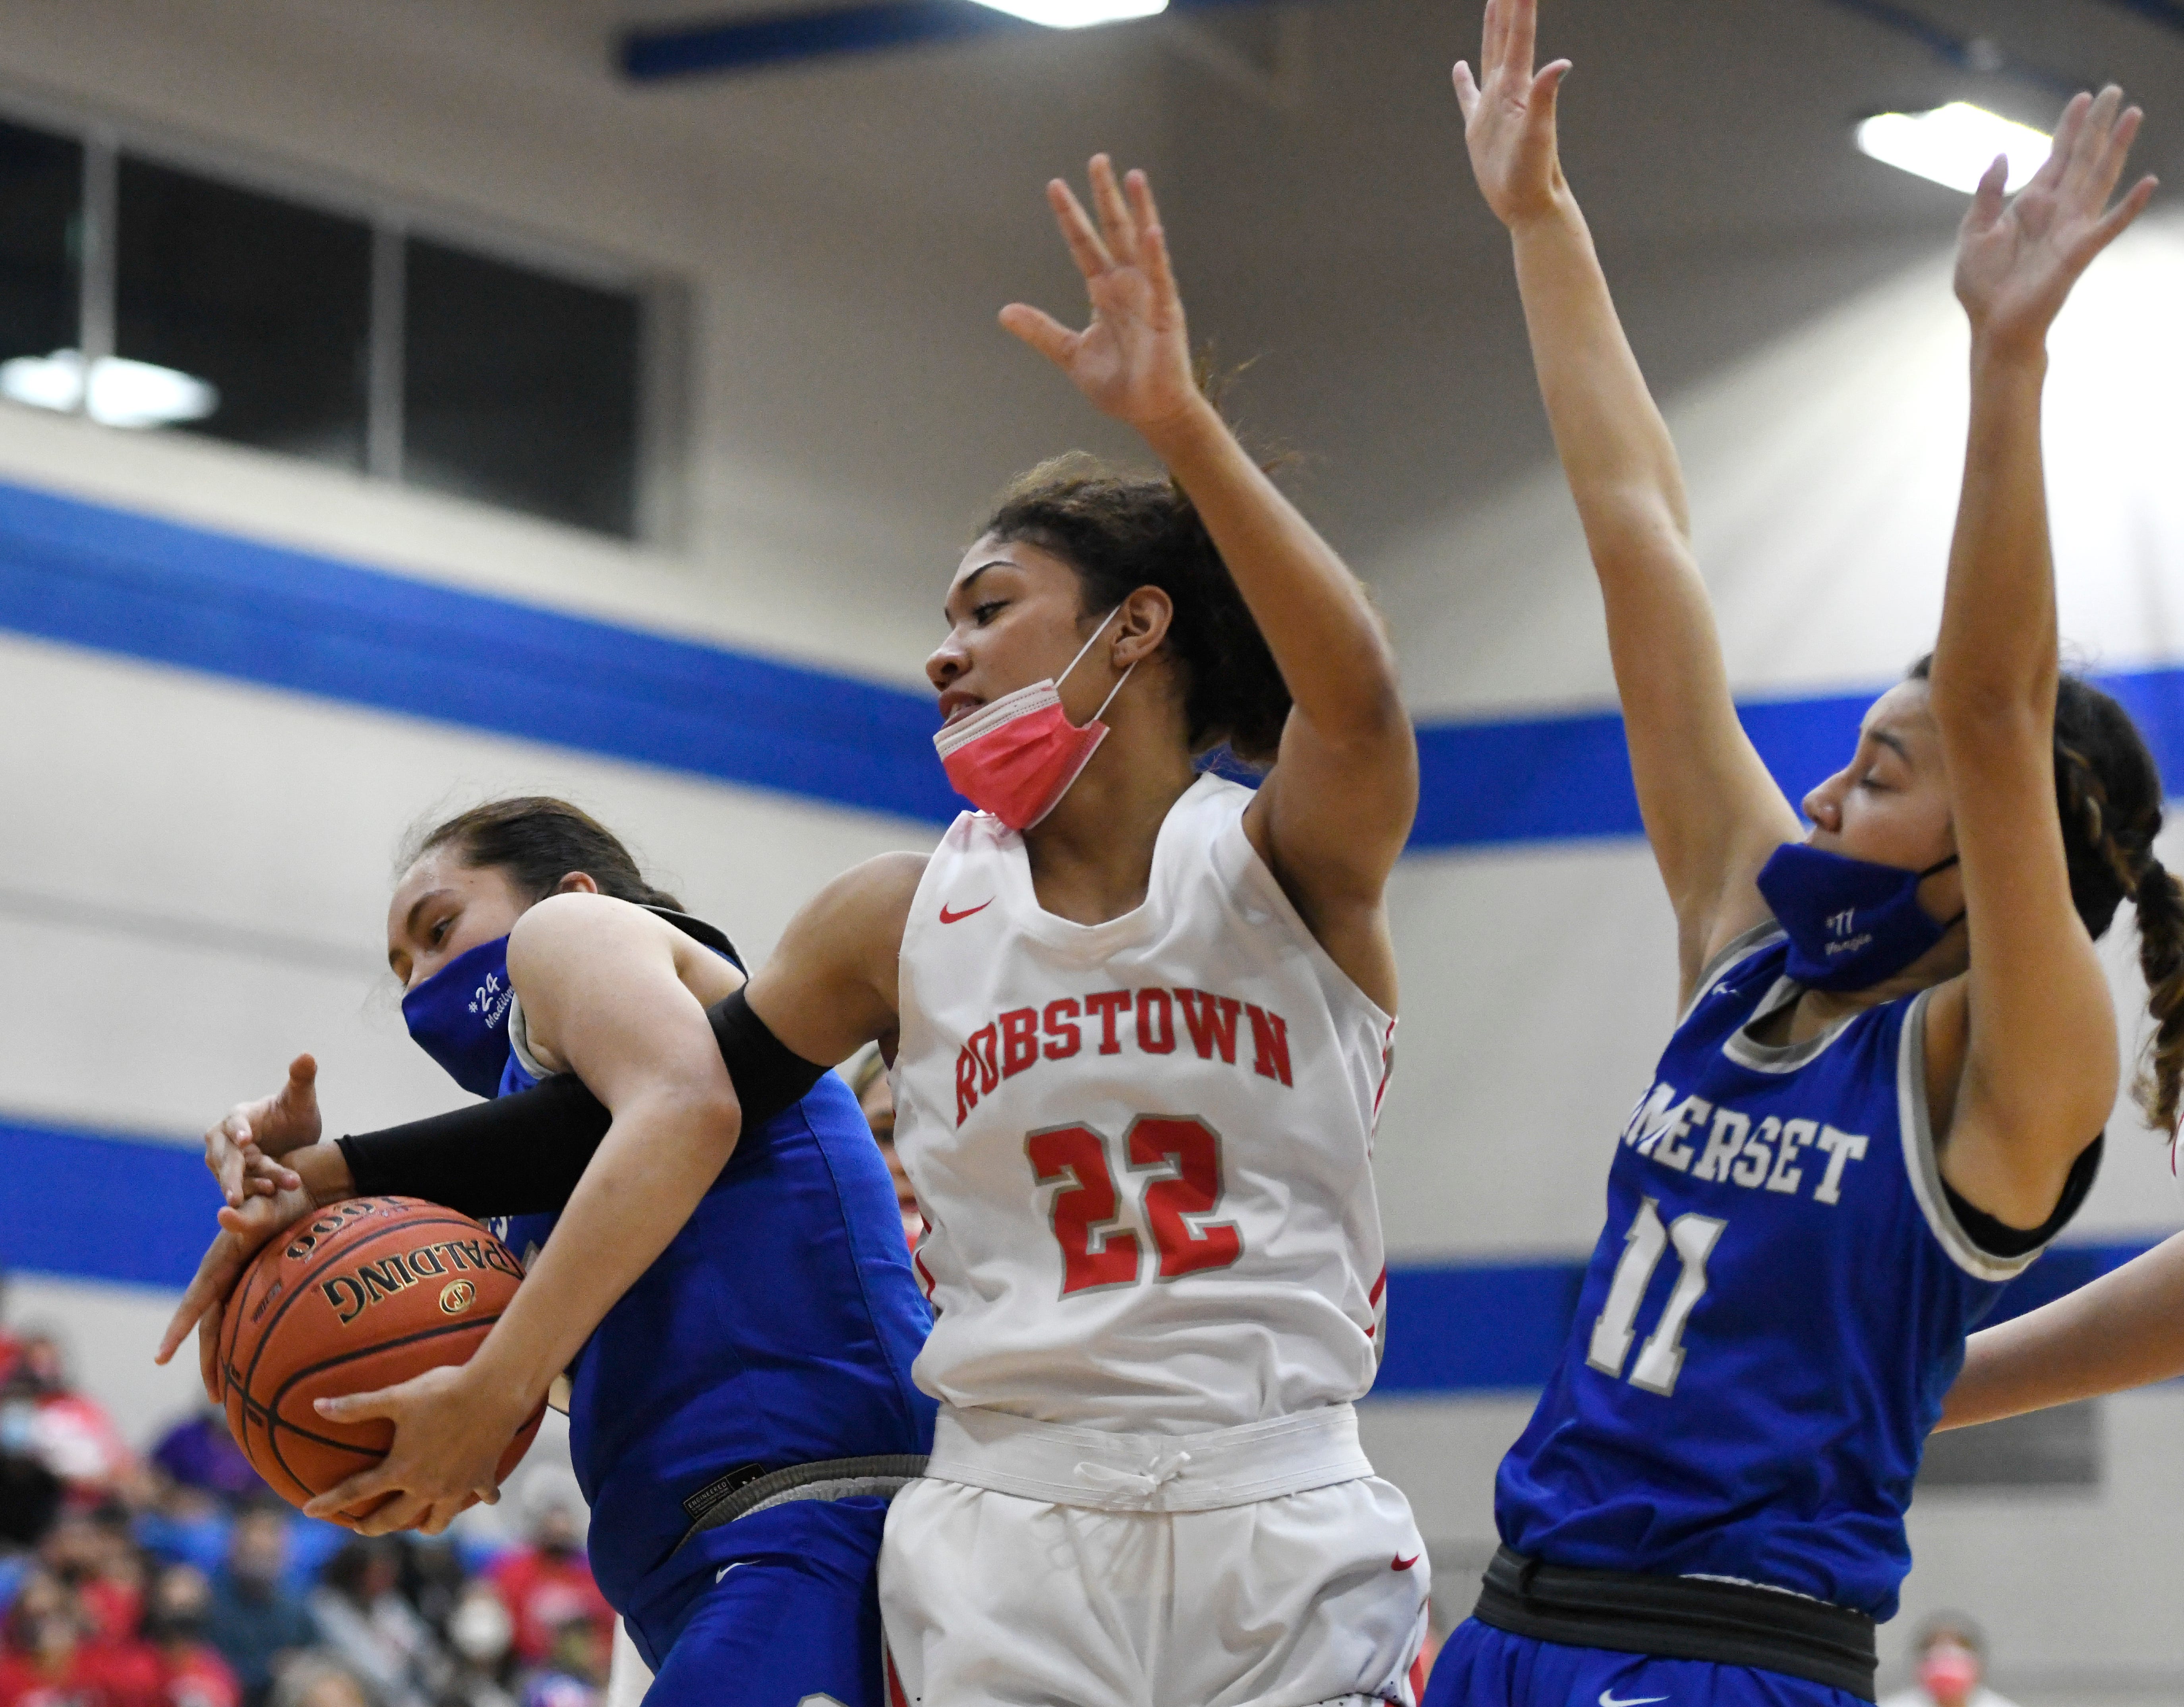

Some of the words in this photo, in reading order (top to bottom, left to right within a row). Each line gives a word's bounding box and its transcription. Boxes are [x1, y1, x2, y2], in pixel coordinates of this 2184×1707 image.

[468, 972, 500, 1013] #24
[954, 987, 1294, 1129] ROBSTOWN
[1023, 1112, 1244, 1302] 22
[1622, 1081, 1870, 1206] MERSET
[1585, 1194, 1729, 1397] 11
[688, 1482, 727, 1508] ENGINEERED
